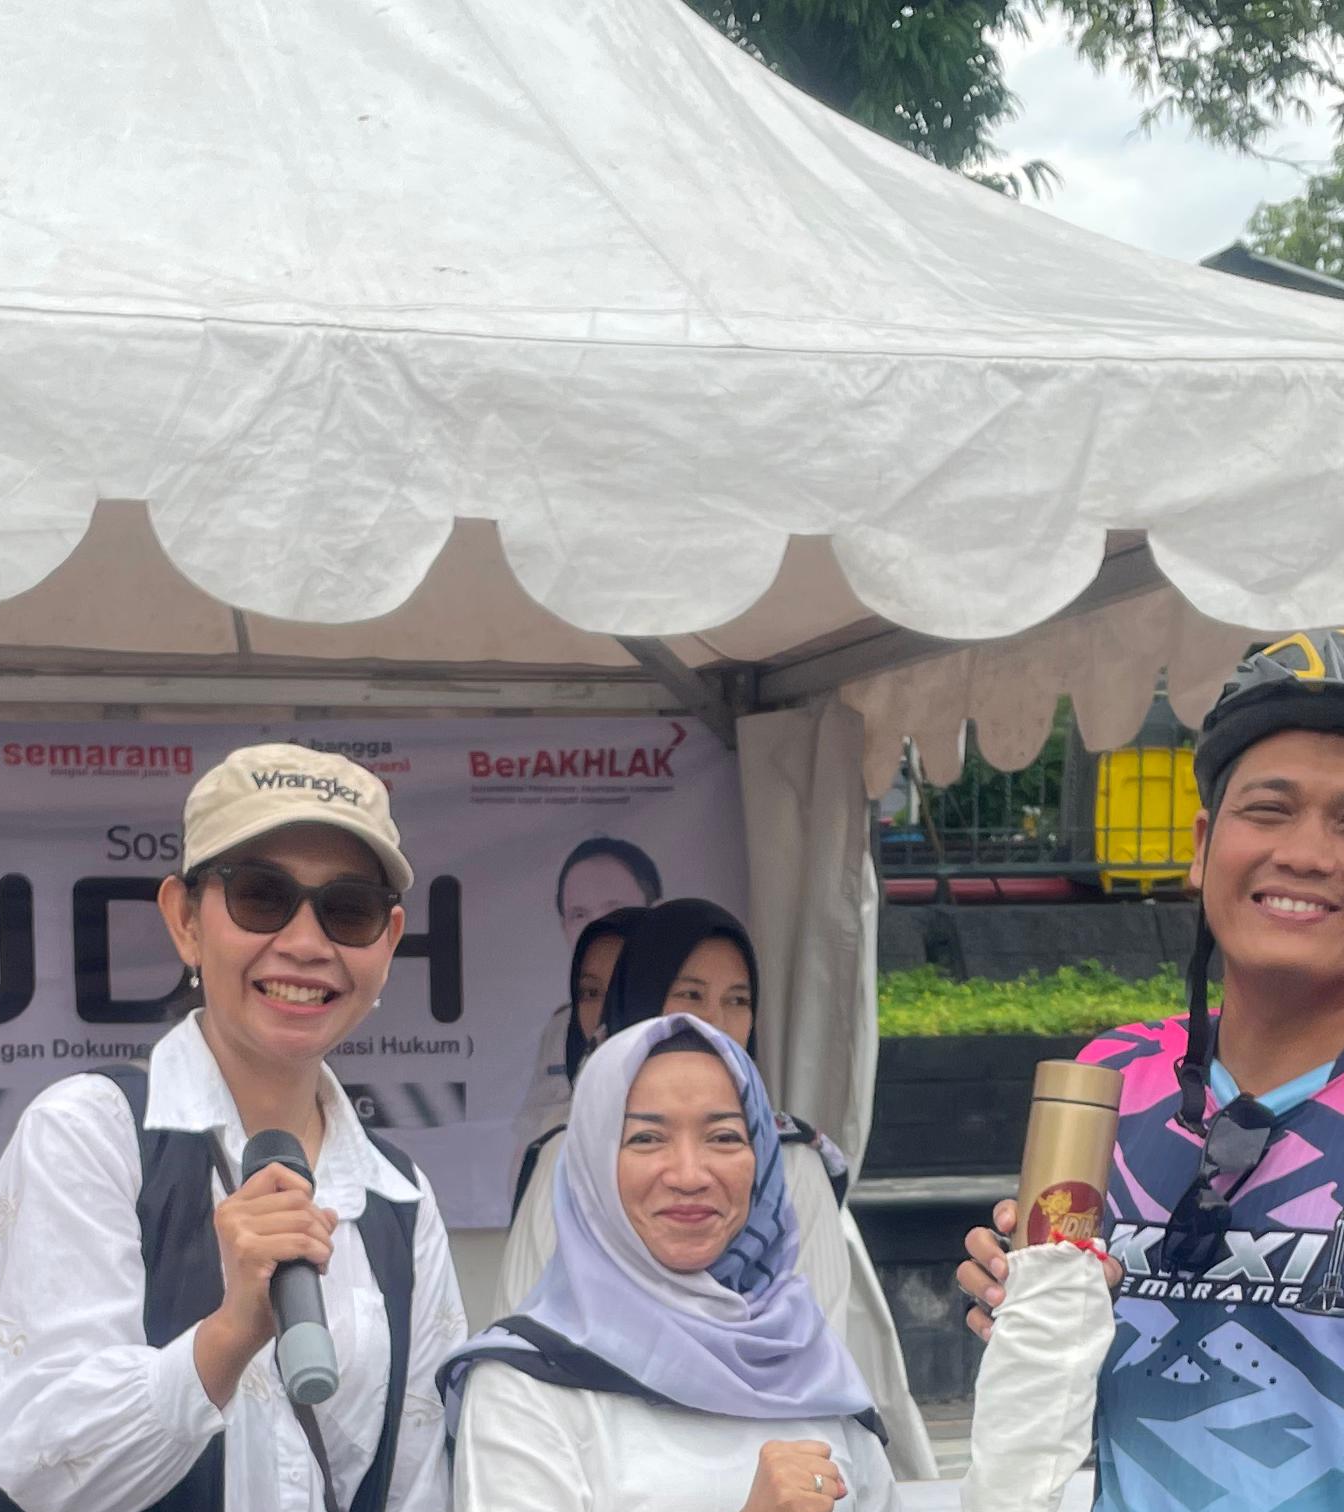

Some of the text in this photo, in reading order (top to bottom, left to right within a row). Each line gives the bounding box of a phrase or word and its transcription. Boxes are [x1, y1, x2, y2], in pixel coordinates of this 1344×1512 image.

[3, 742, 193, 774] semarang
[469, 749, 674, 777] BerAKHLAK
[252, 770, 362, 806] Wrangler
[381, 1036, 460, 1055] Hukum
